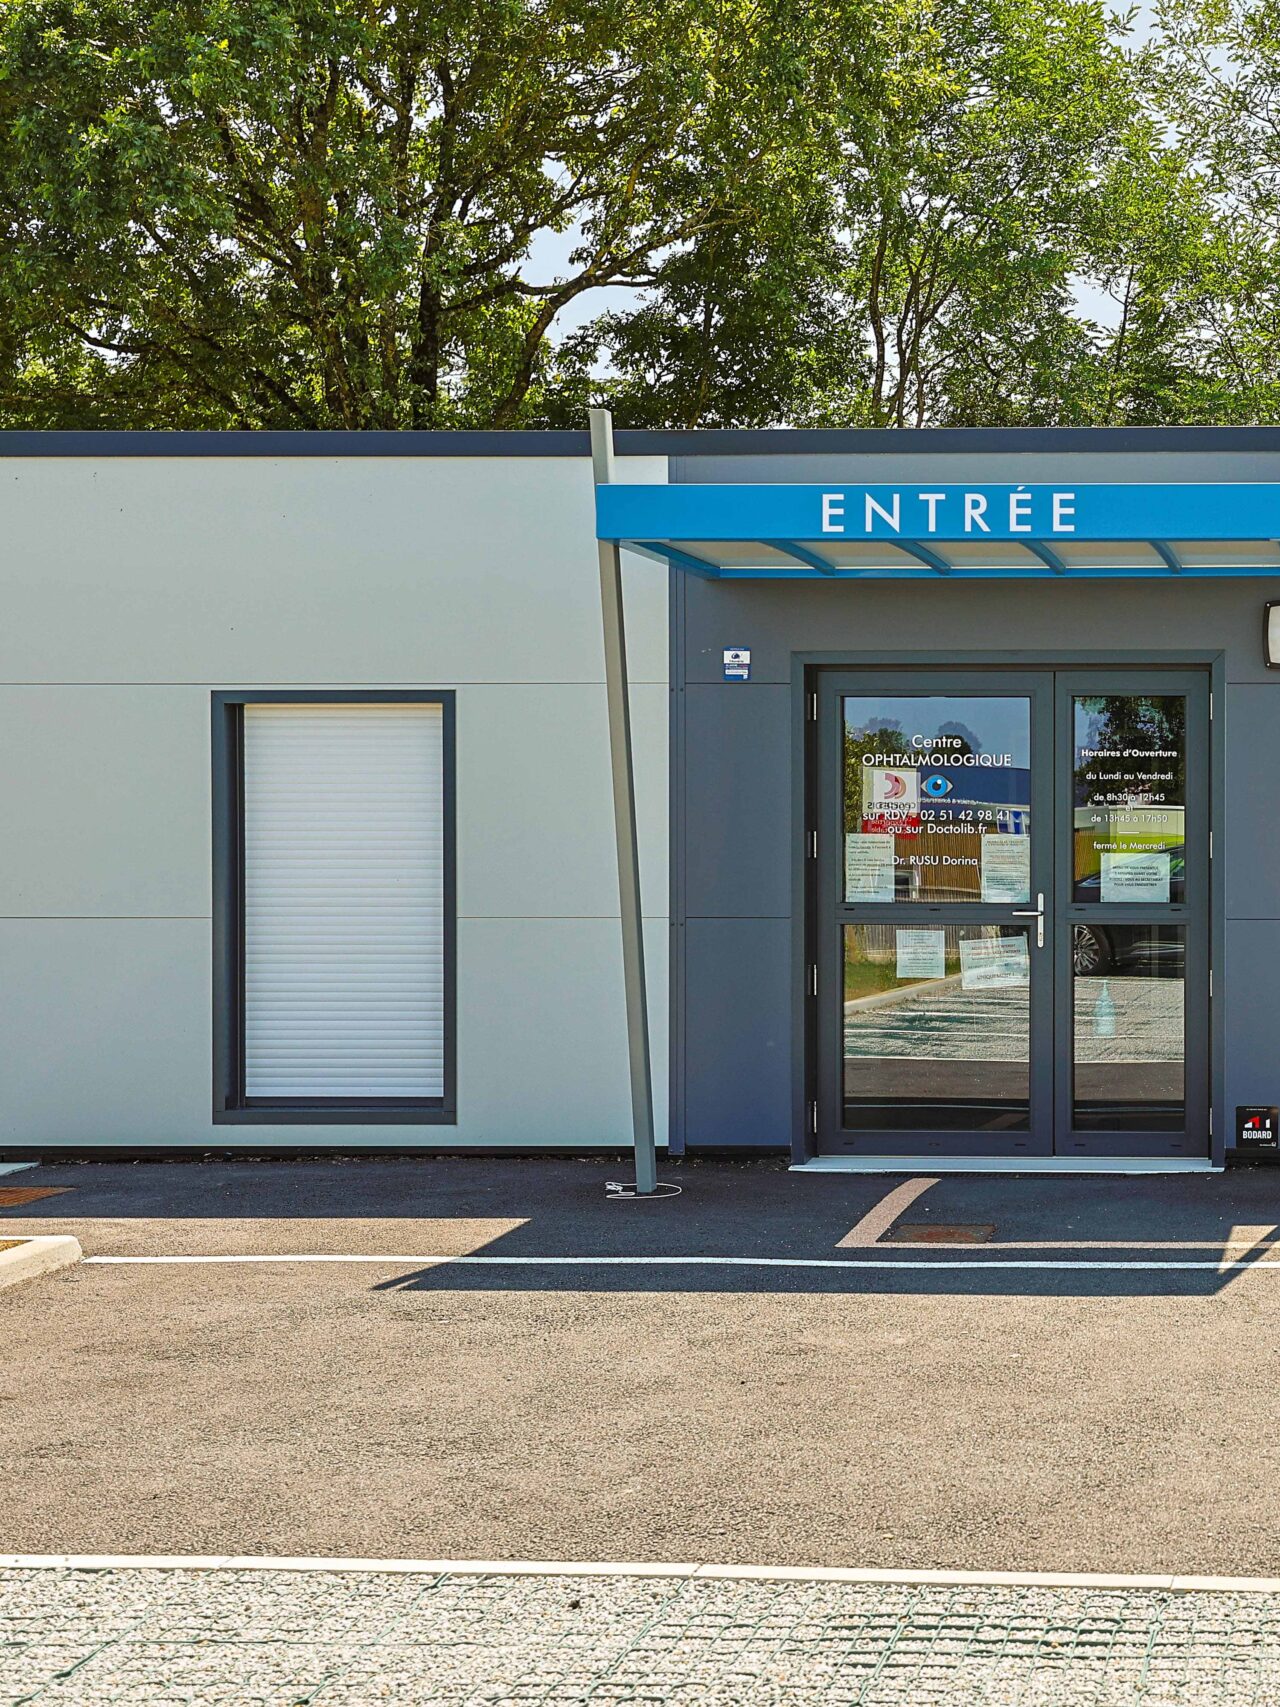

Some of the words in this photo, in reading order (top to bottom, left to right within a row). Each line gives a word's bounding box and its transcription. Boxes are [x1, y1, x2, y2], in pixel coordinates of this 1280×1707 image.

[822, 486, 1075, 533] ENTRÉE
[911, 734, 962, 748] Centre
[1081, 748, 1121, 757] Horaires
[1123, 748, 1178, 757] d'Ouverture
[861, 753, 1012, 767] OPHTALMOLOGIQUE
[1086, 771, 1097, 780] du
[1099, 771, 1122, 780] Lundi
[1136, 771, 1174, 780] Vendredi
[1093, 792, 1105, 801] de
[1107, 792, 1129, 801] 8h30
[1139, 792, 1166, 801] 12h45
[862, 811, 881, 821] sur
[883, 809, 908, 821] RDV
[920, 809, 936, 821] 02
[939, 809, 953, 821] 51
[958, 809, 973, 821] 42
[977, 809, 993, 821] 98
[996, 809, 1010, 821] 41
[1091, 814, 1102, 823] de
[1104, 814, 1131, 823] 13h45
[1141, 814, 1168, 823] 17h50
[887, 825, 902, 834] ou
[906, 825, 924, 834] sur
[927, 822, 988, 834] Doctolib.fr
[1093, 841, 1118, 851] fermé
[1119, 841, 1127, 851] le
[1130, 841, 1166, 851] Mercredi
[891, 855, 906, 866] Dr.
[909, 855, 939, 866] RUSU
[942, 855, 978, 866] Dorina
[1242, 1130, 1272, 1139] BODARD
